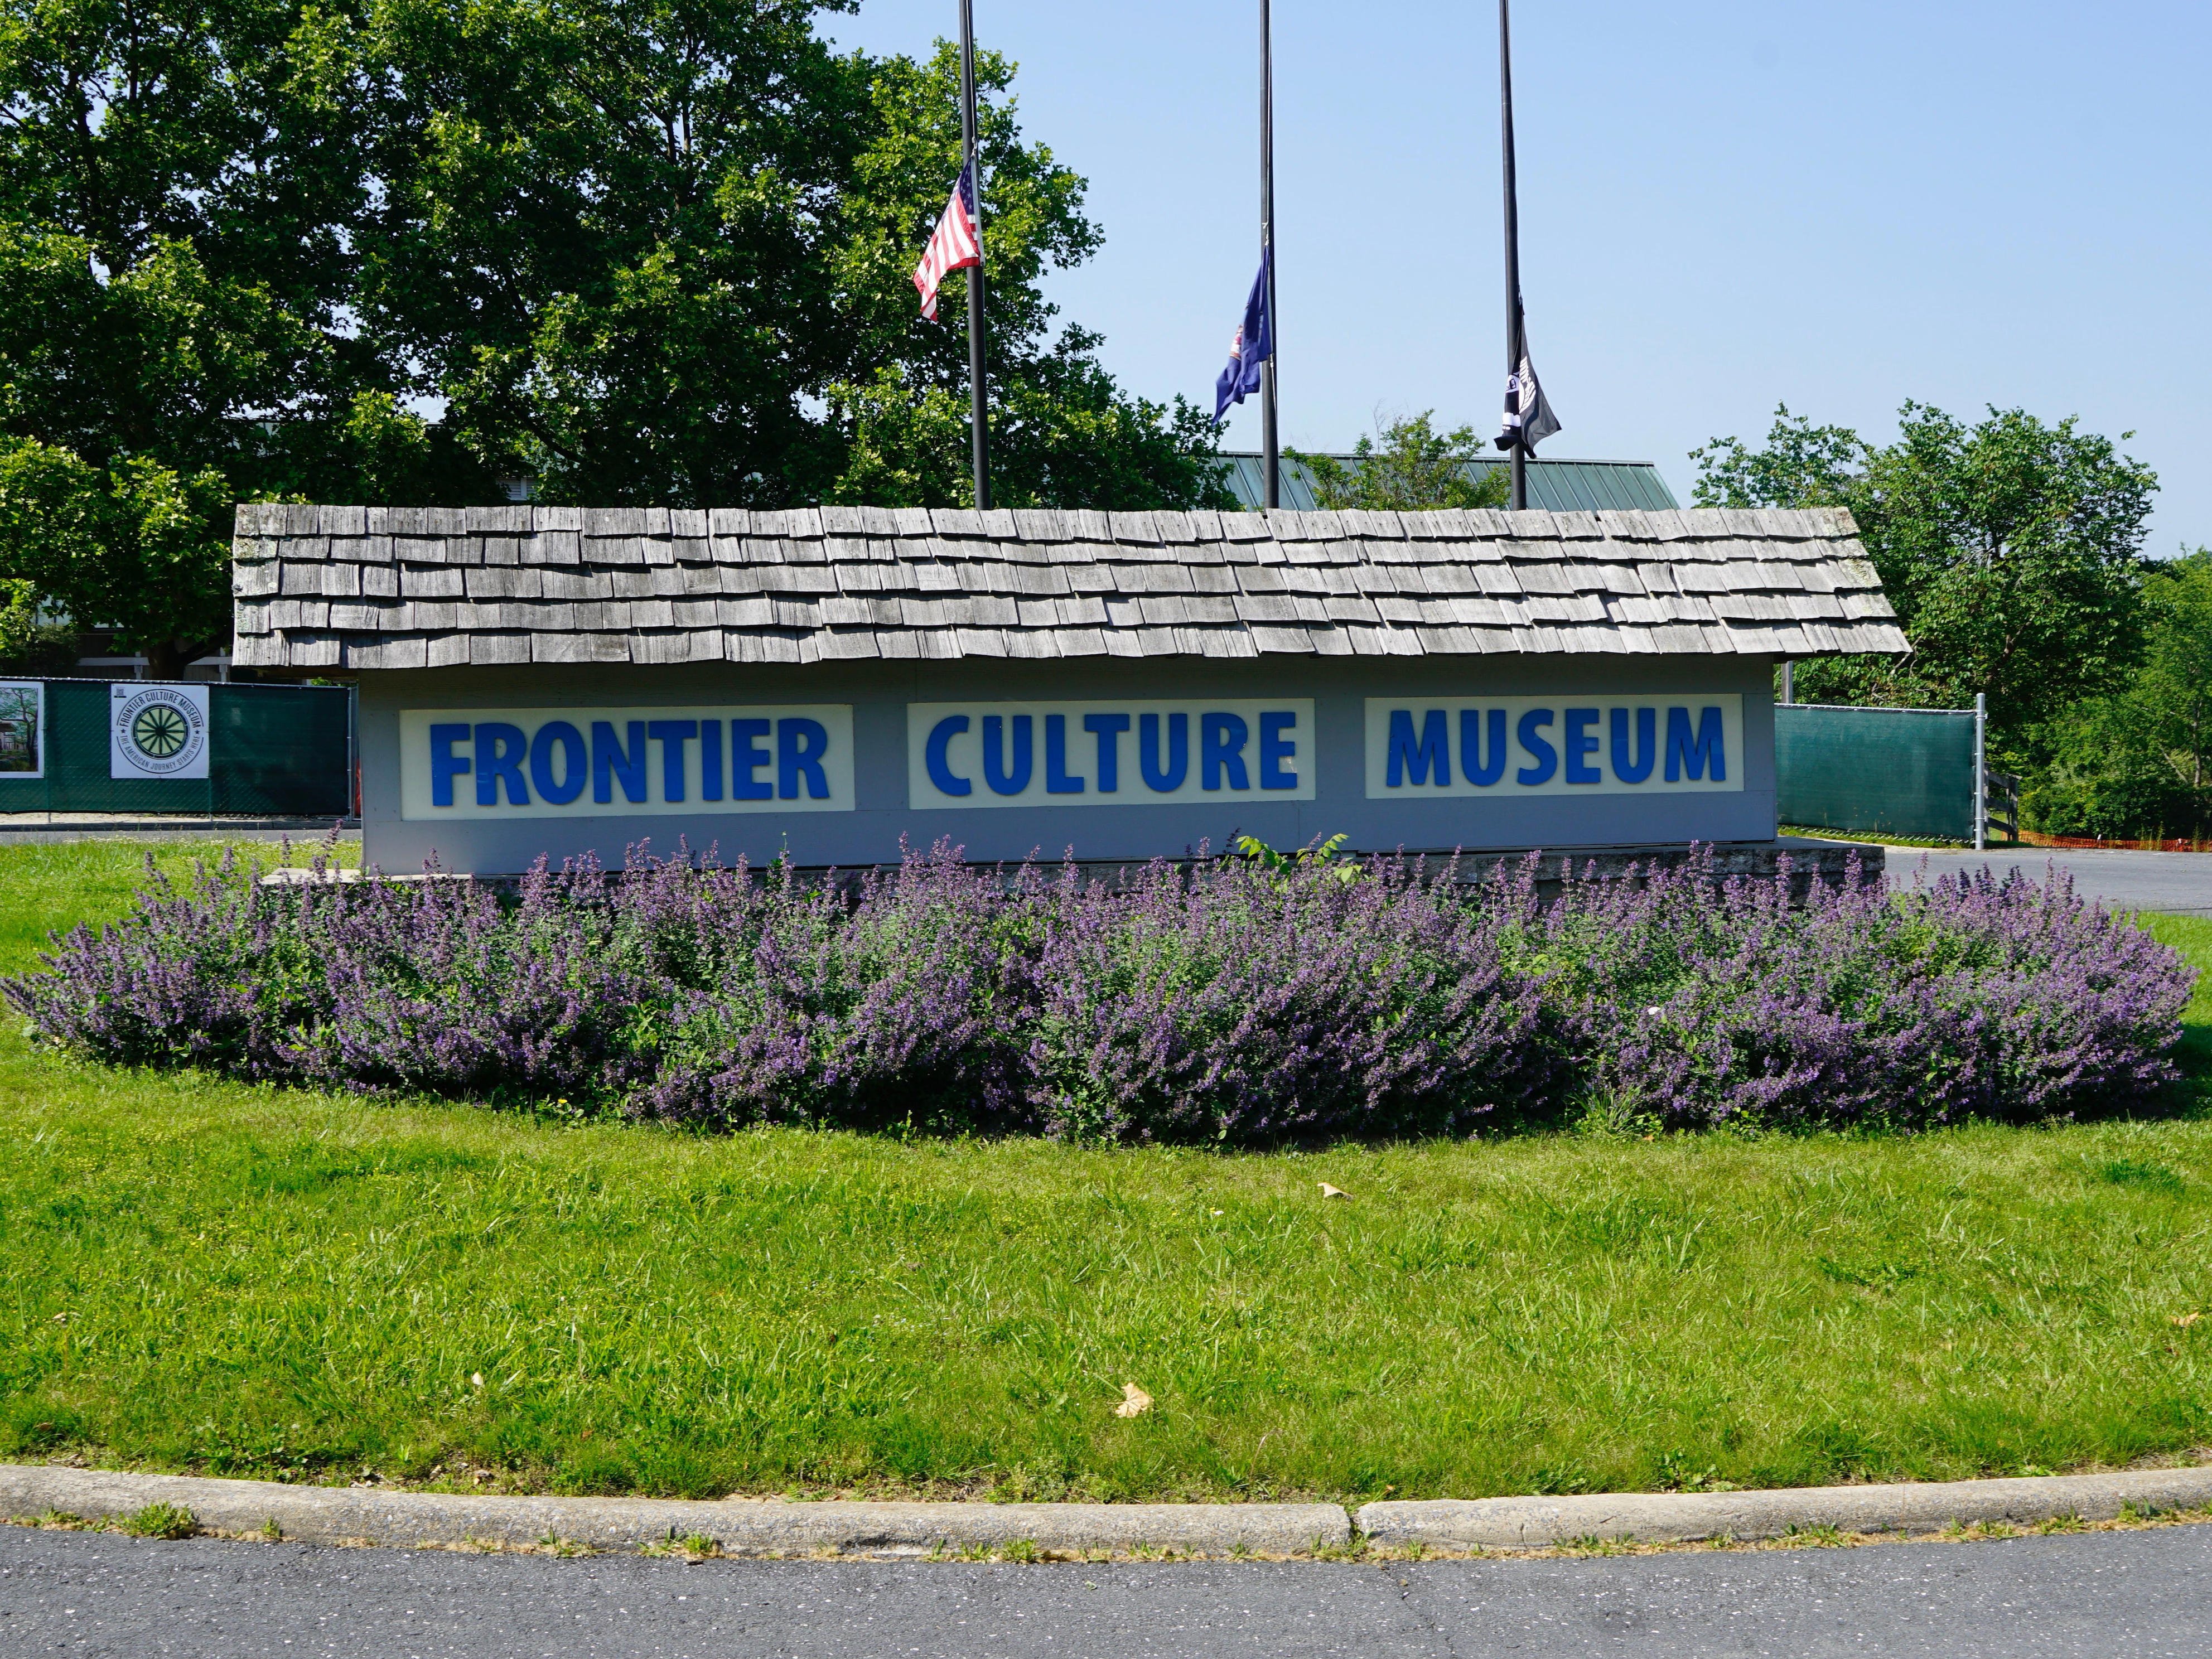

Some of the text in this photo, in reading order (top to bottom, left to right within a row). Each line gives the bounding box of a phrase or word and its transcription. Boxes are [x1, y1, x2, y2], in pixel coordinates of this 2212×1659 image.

[120, 691, 201, 728] FRONTIER CULTURE MUSEUM
[120, 736, 200, 770] THE AMERICAN JOURNEY STARTS HERE
[430, 707, 1726, 806] FRONTIER CULTURE MUSEUM
